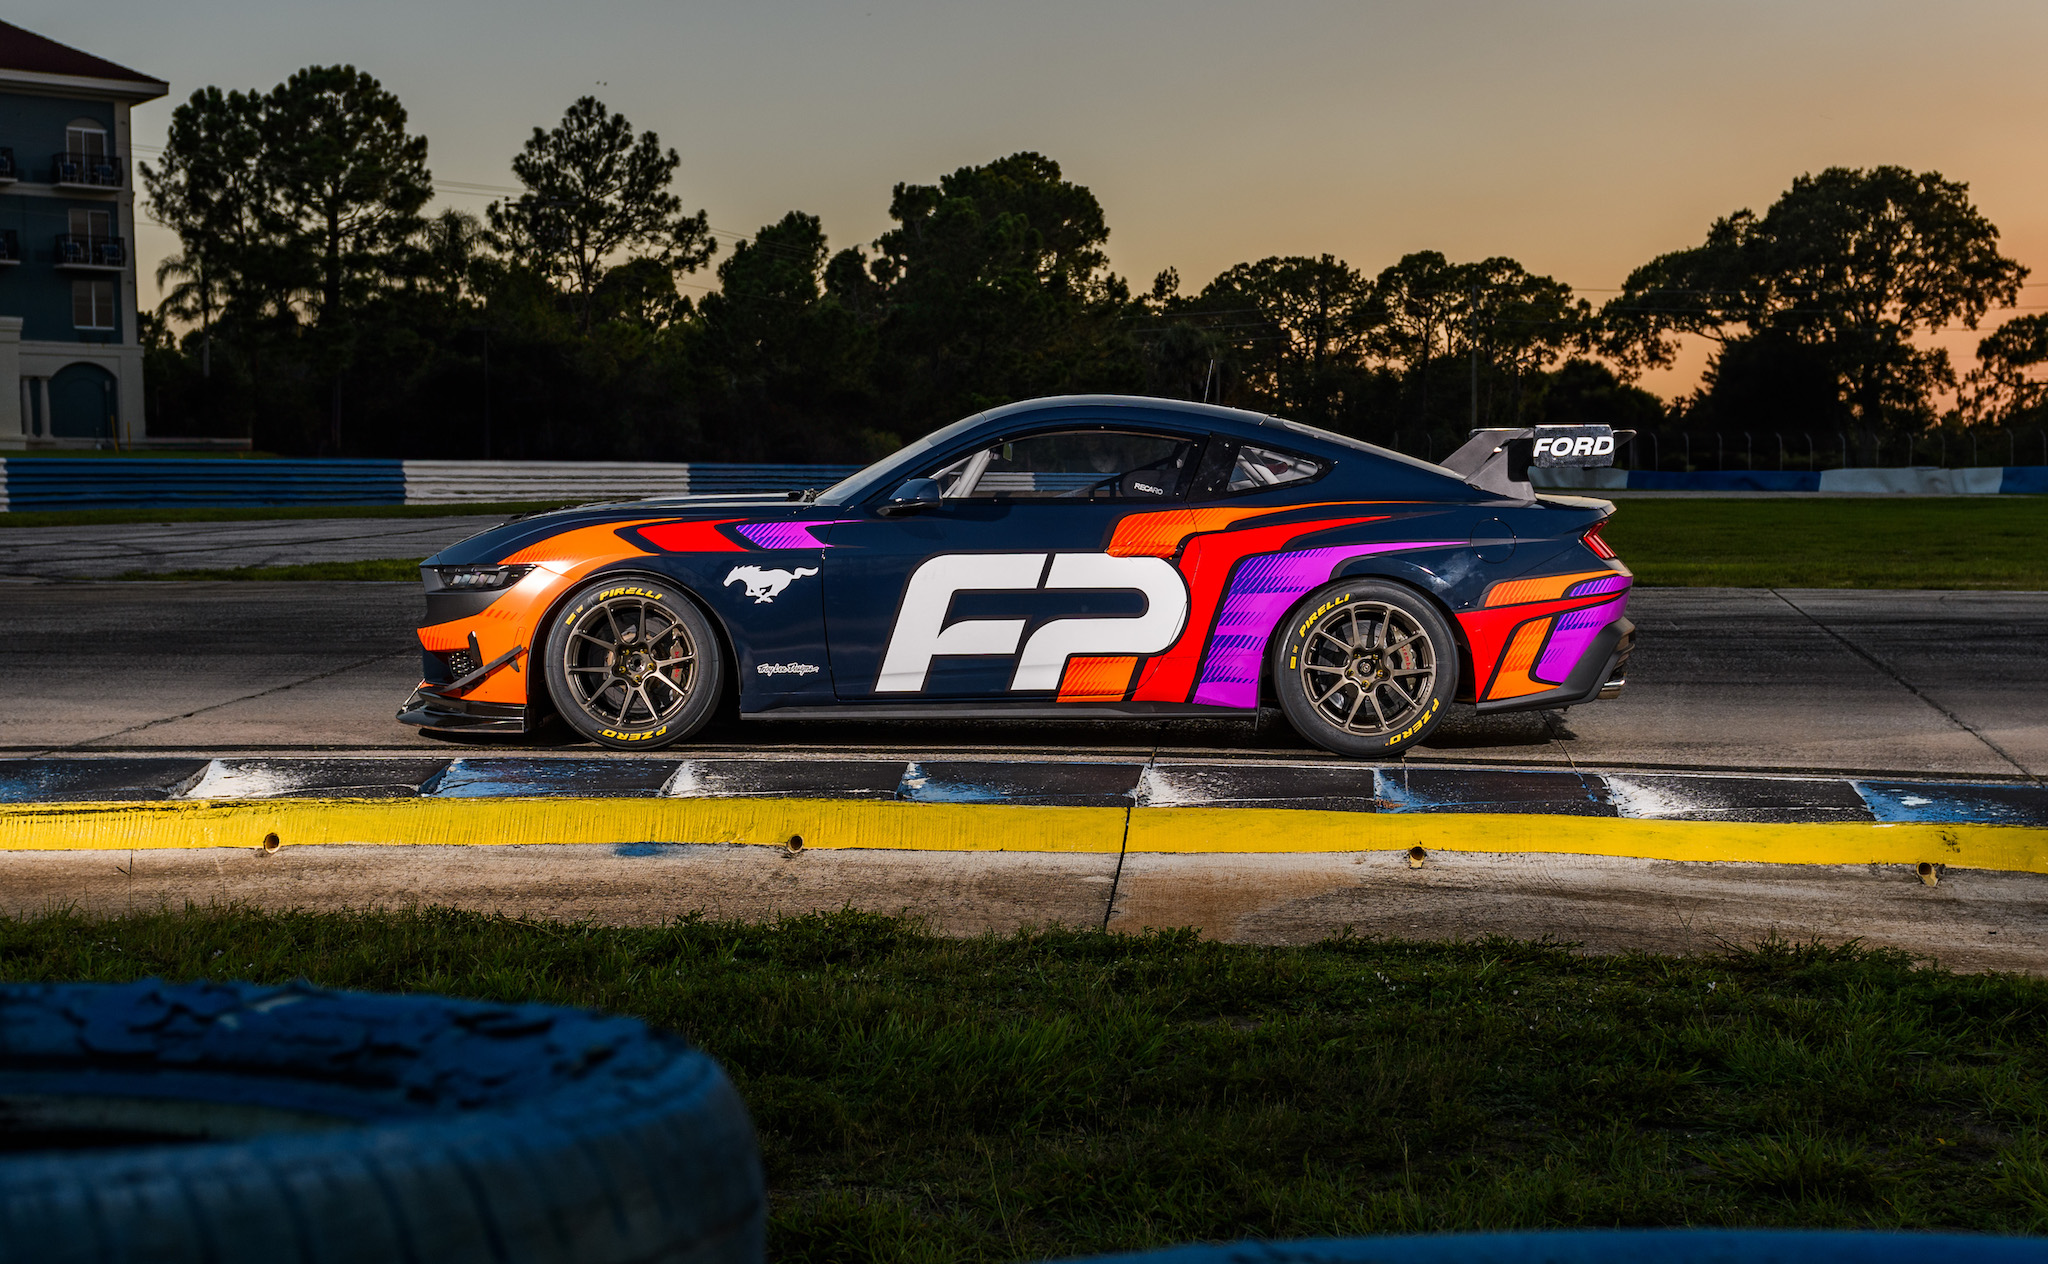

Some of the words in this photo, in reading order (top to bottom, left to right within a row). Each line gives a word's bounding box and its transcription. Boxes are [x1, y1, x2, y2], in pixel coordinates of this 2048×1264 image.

[1533, 436, 1615, 458] FORD
[1134, 482, 1164, 496] RECARO
[599, 586, 663, 602] PIRELLI
[874, 552, 1188, 692] FP
[1297, 593, 1351, 638] PIRELLI
